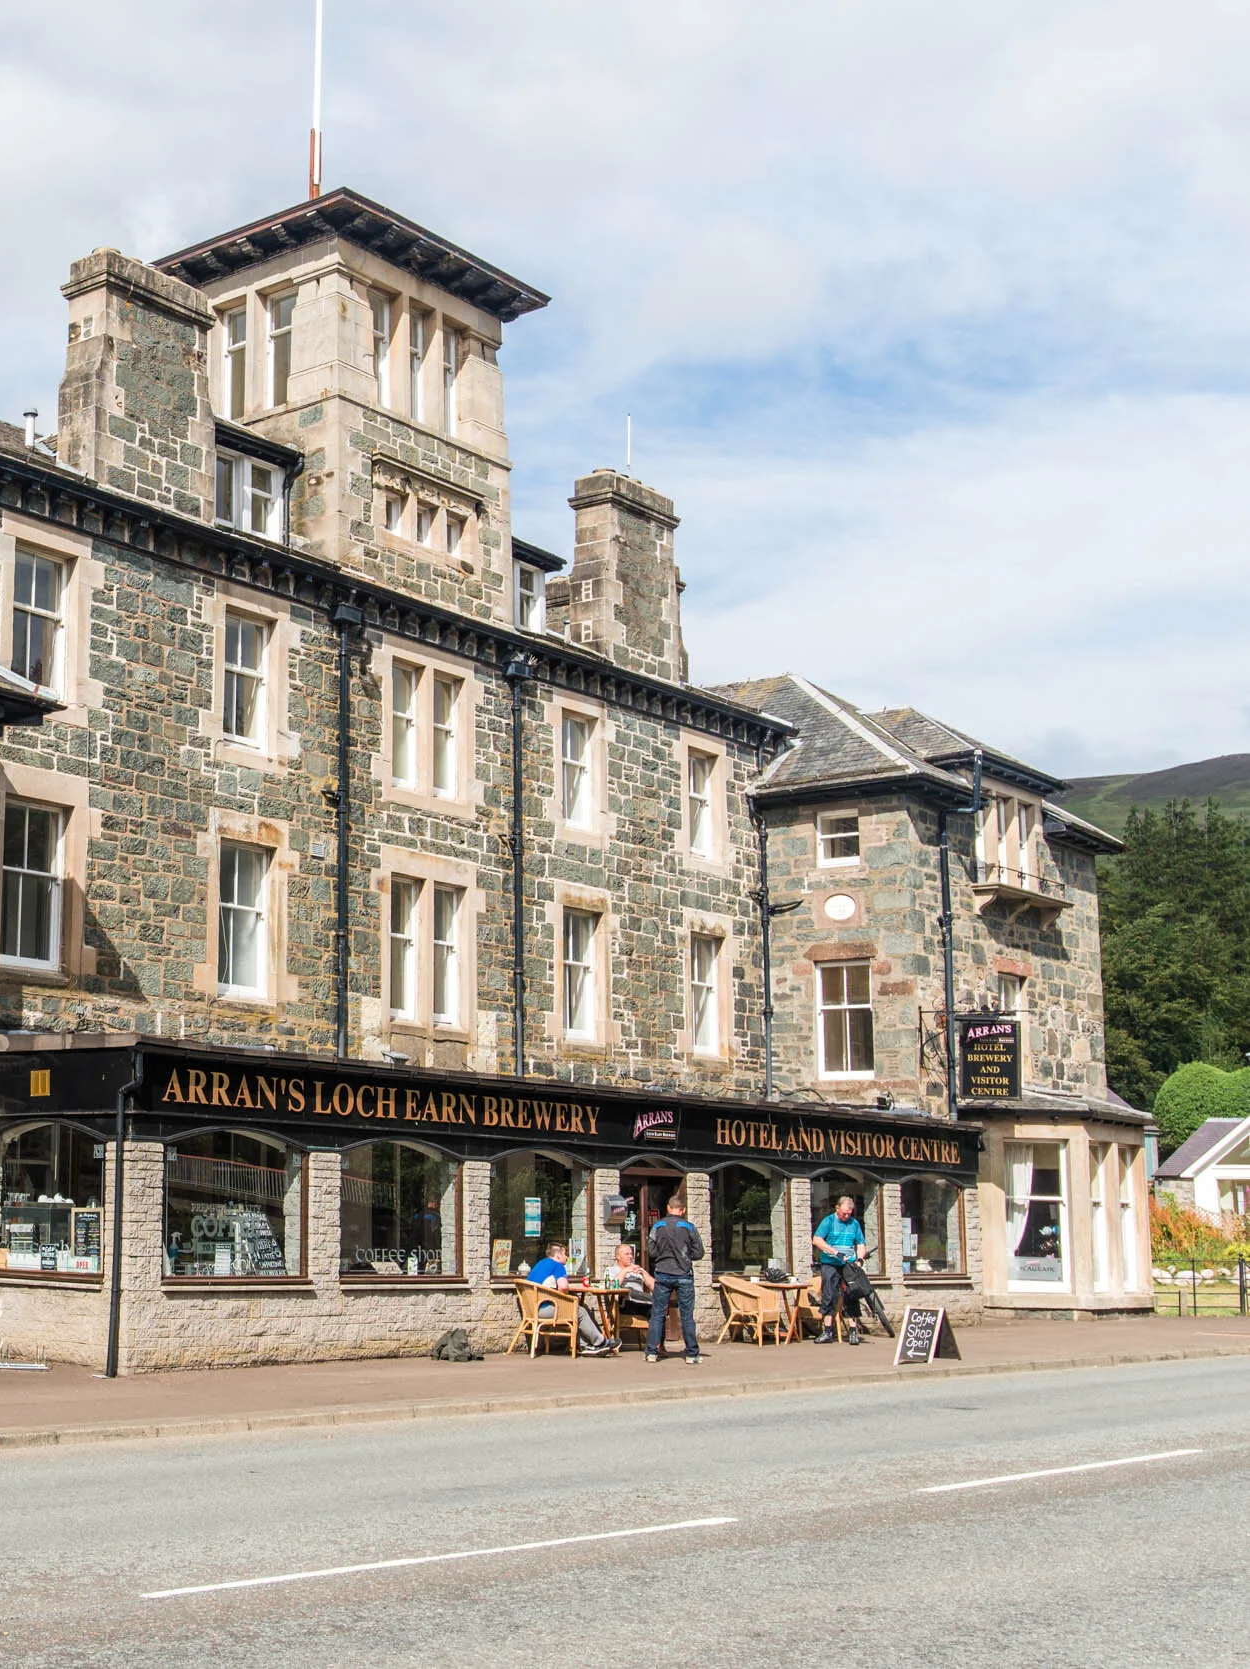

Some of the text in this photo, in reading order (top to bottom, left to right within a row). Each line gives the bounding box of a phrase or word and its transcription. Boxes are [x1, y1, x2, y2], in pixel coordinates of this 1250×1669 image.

[974, 1043, 1006, 1052] HOTEL
[967, 1053, 1013, 1063] BREWERY
[980, 1065, 1000, 1074] AND
[971, 1076, 1009, 1085] VISITOR
[971, 1087, 1009, 1096] CENTRE
[162, 1067, 600, 1135] ARRAN'S LOCH EARN BREWERY
[716, 1118, 961, 1165] HOTEL AND VISITOR CENTRE
[911, 1311, 937, 1327] Coffee
[906, 1324, 932, 1340] Shop
[905, 1338, 929, 1350] Open
